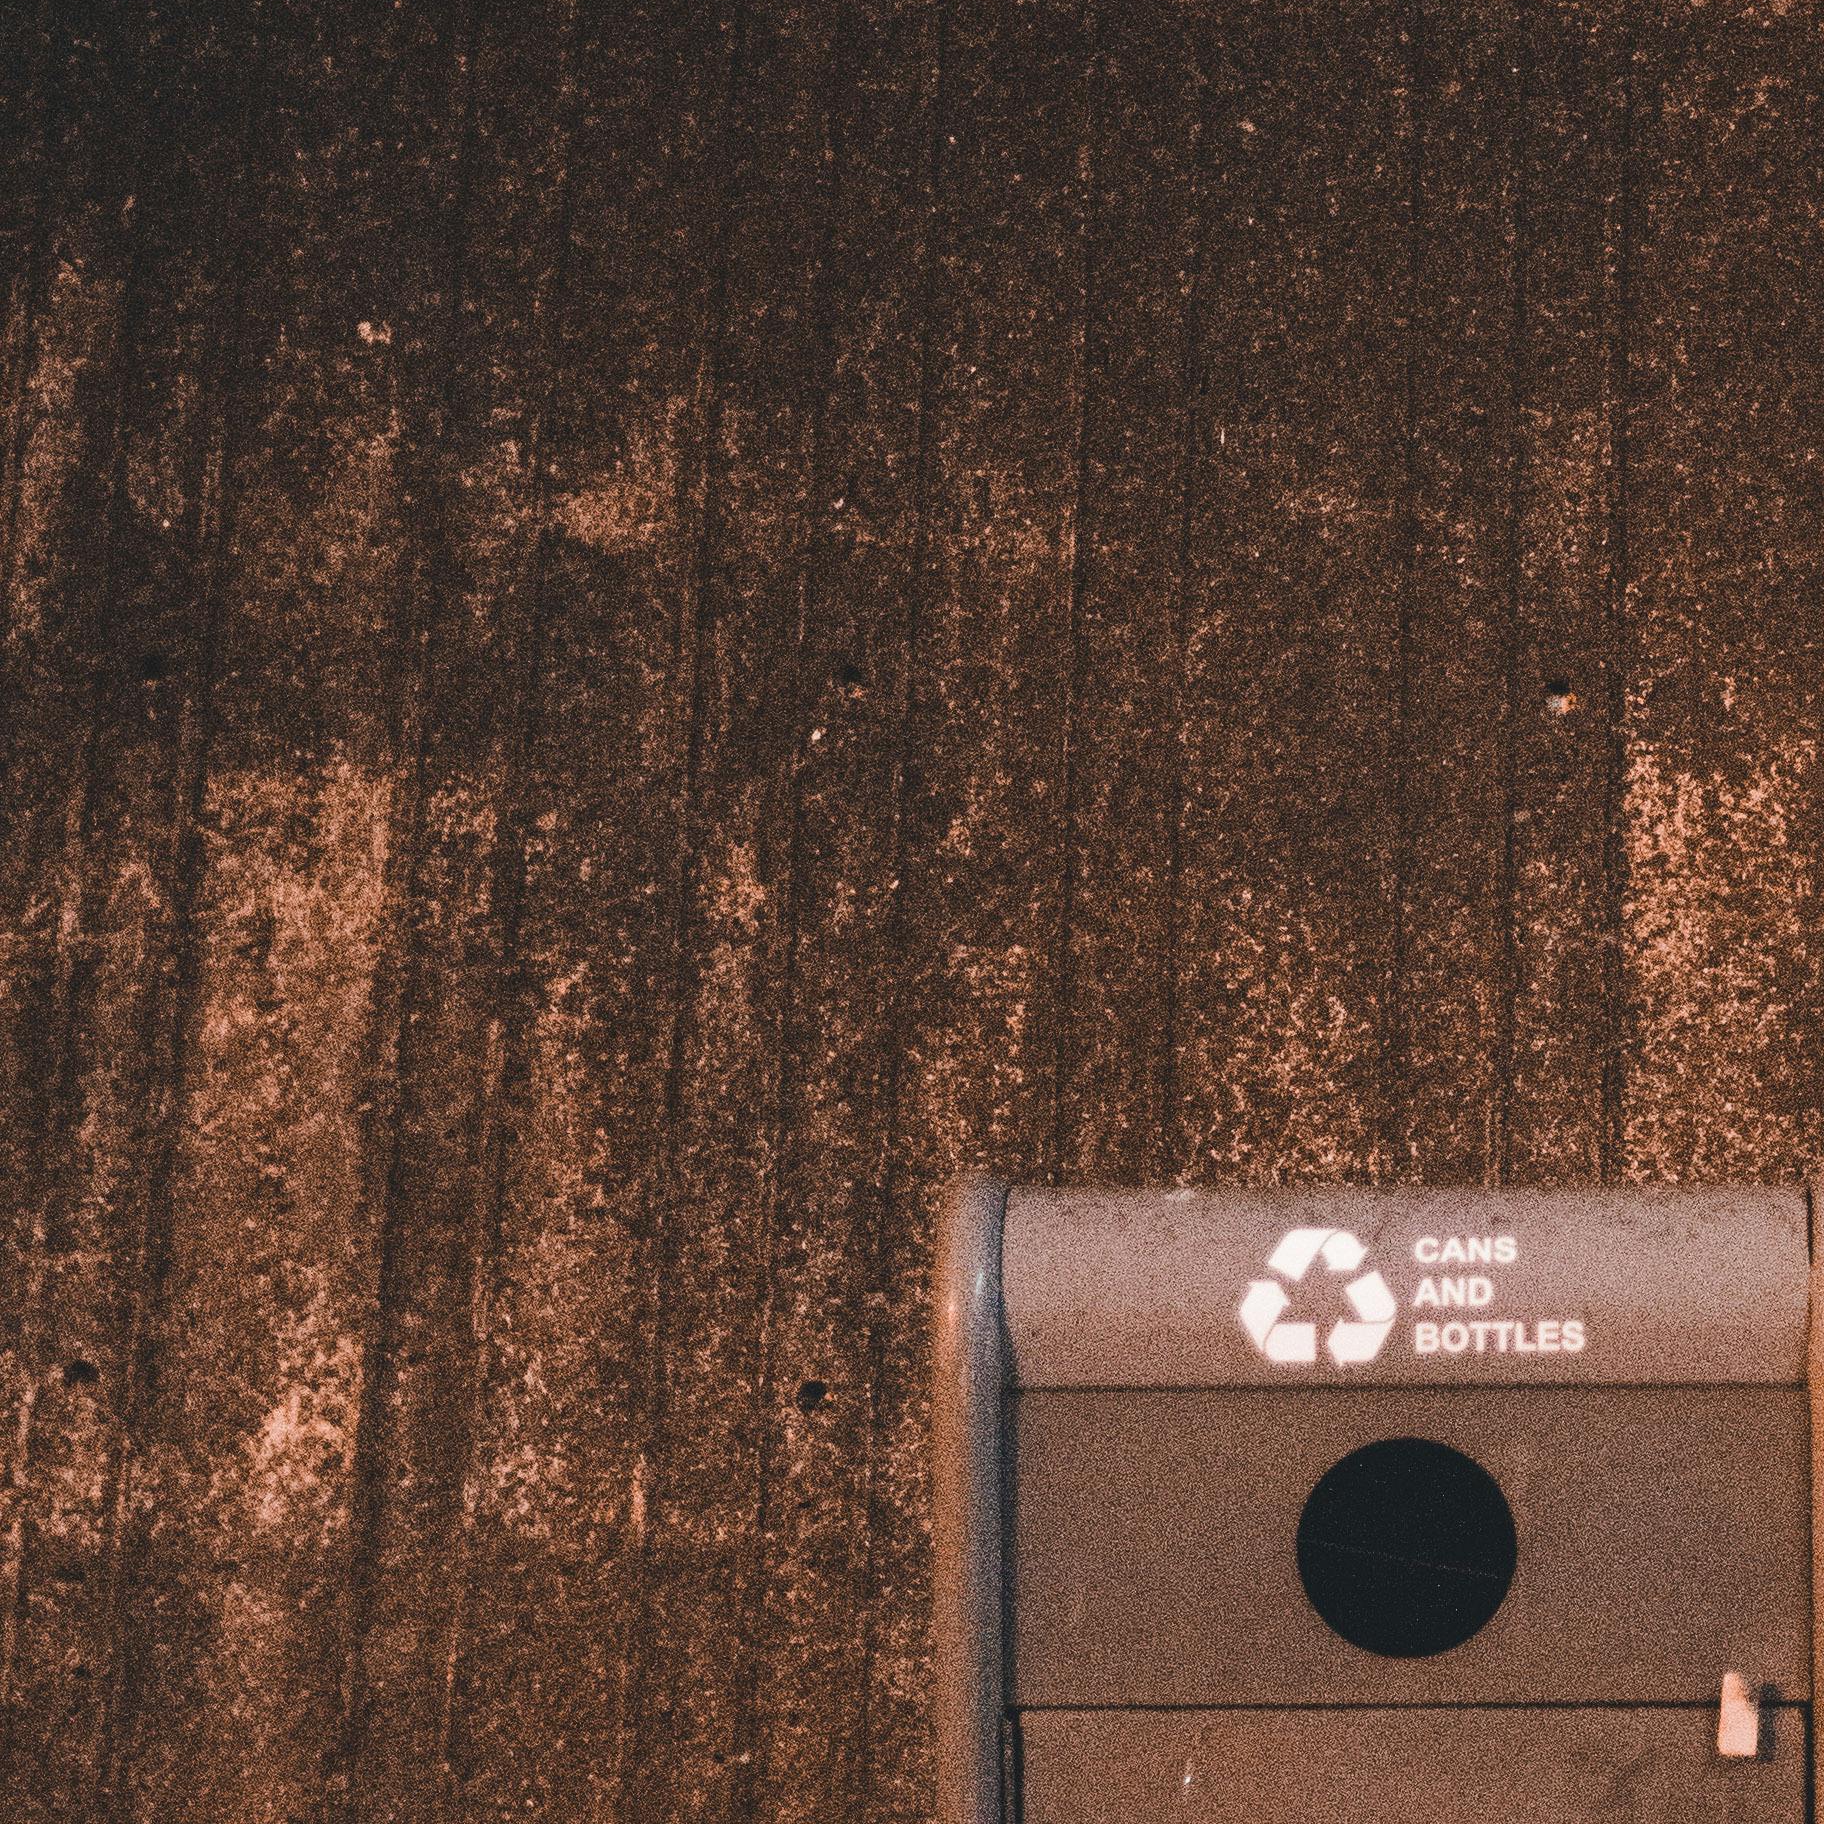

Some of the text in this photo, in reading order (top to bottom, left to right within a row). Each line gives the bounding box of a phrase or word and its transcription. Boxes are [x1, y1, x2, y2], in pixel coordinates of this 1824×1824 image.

[1413, 1235, 1518, 1264] CANS
[1413, 1276, 1494, 1307] AND
[1413, 1320, 1586, 1354] BOTTLES
